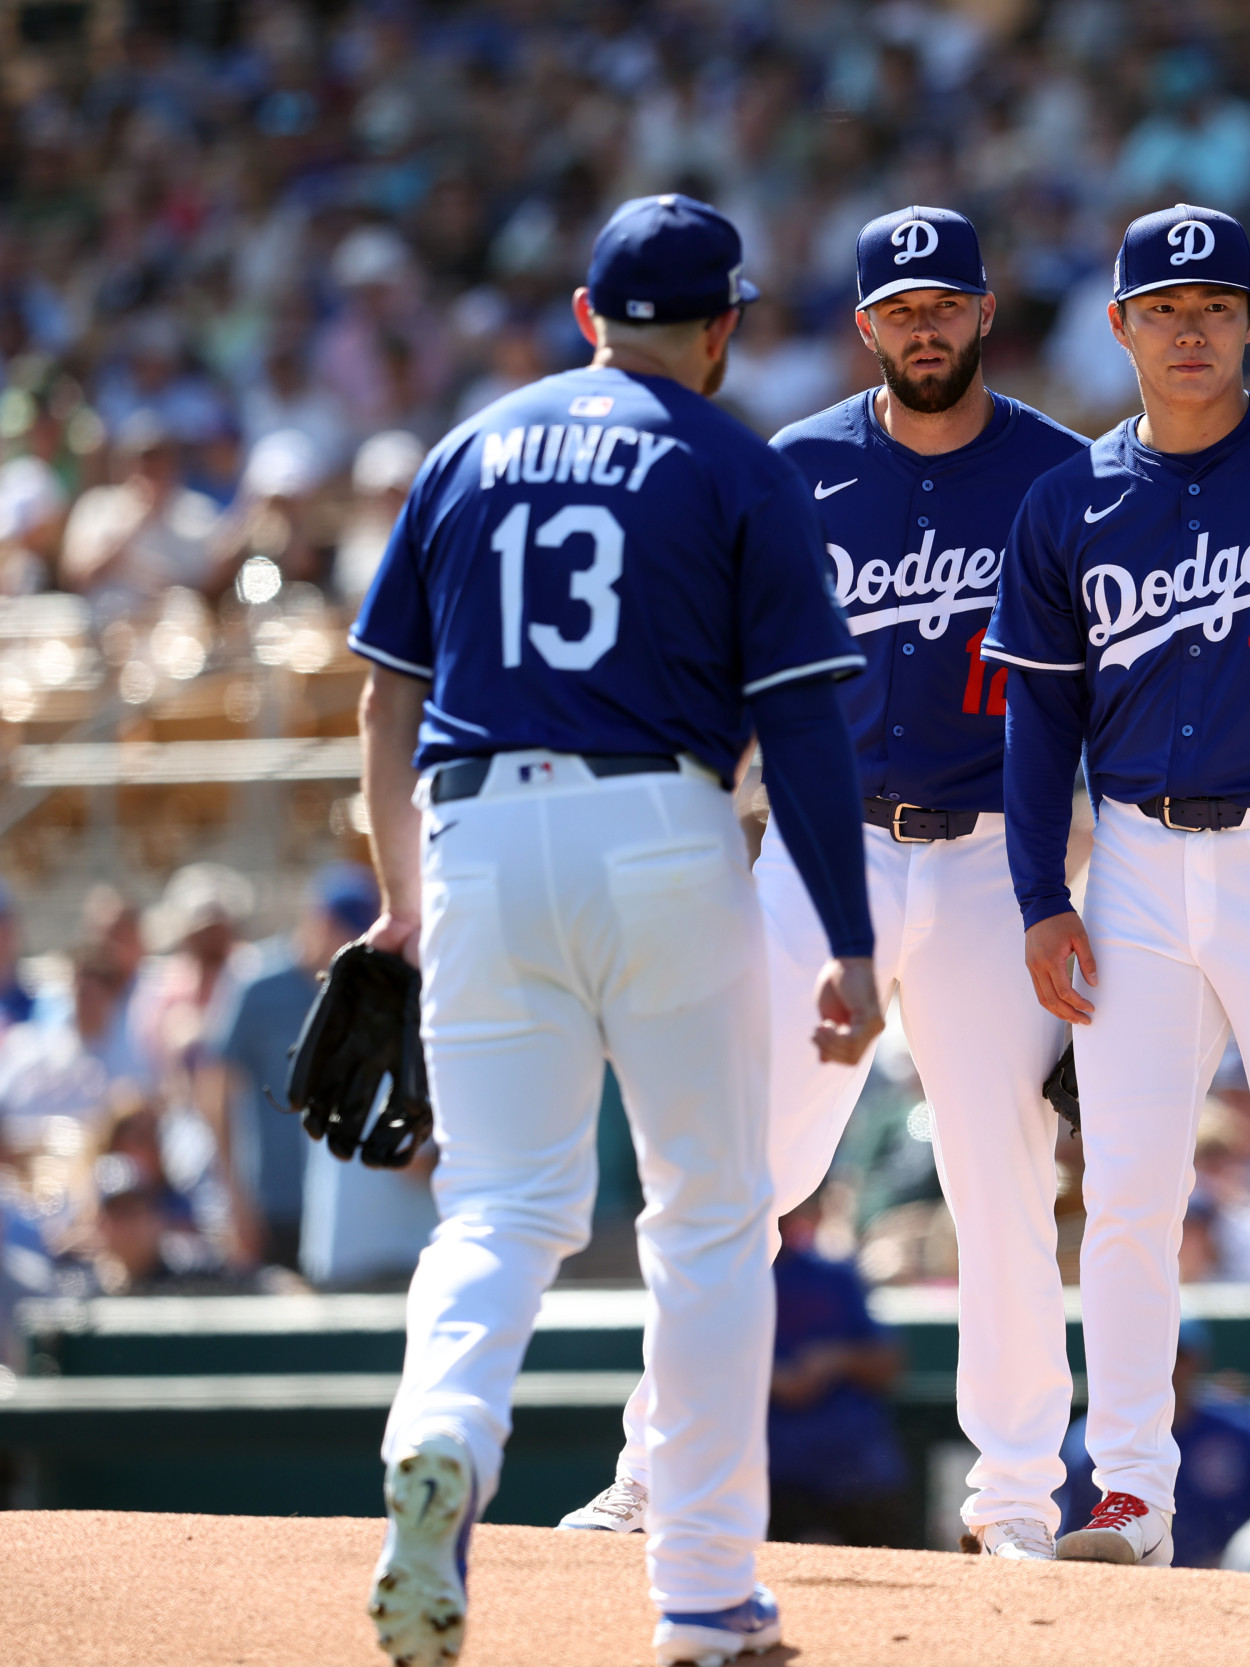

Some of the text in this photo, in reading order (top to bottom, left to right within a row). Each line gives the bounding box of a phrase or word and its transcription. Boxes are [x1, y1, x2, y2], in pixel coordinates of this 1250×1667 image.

[891, 220, 939, 265] D
[1167, 220, 1216, 266] D
[480, 424, 677, 492] MUNCY
[491, 503, 625, 671] 13
